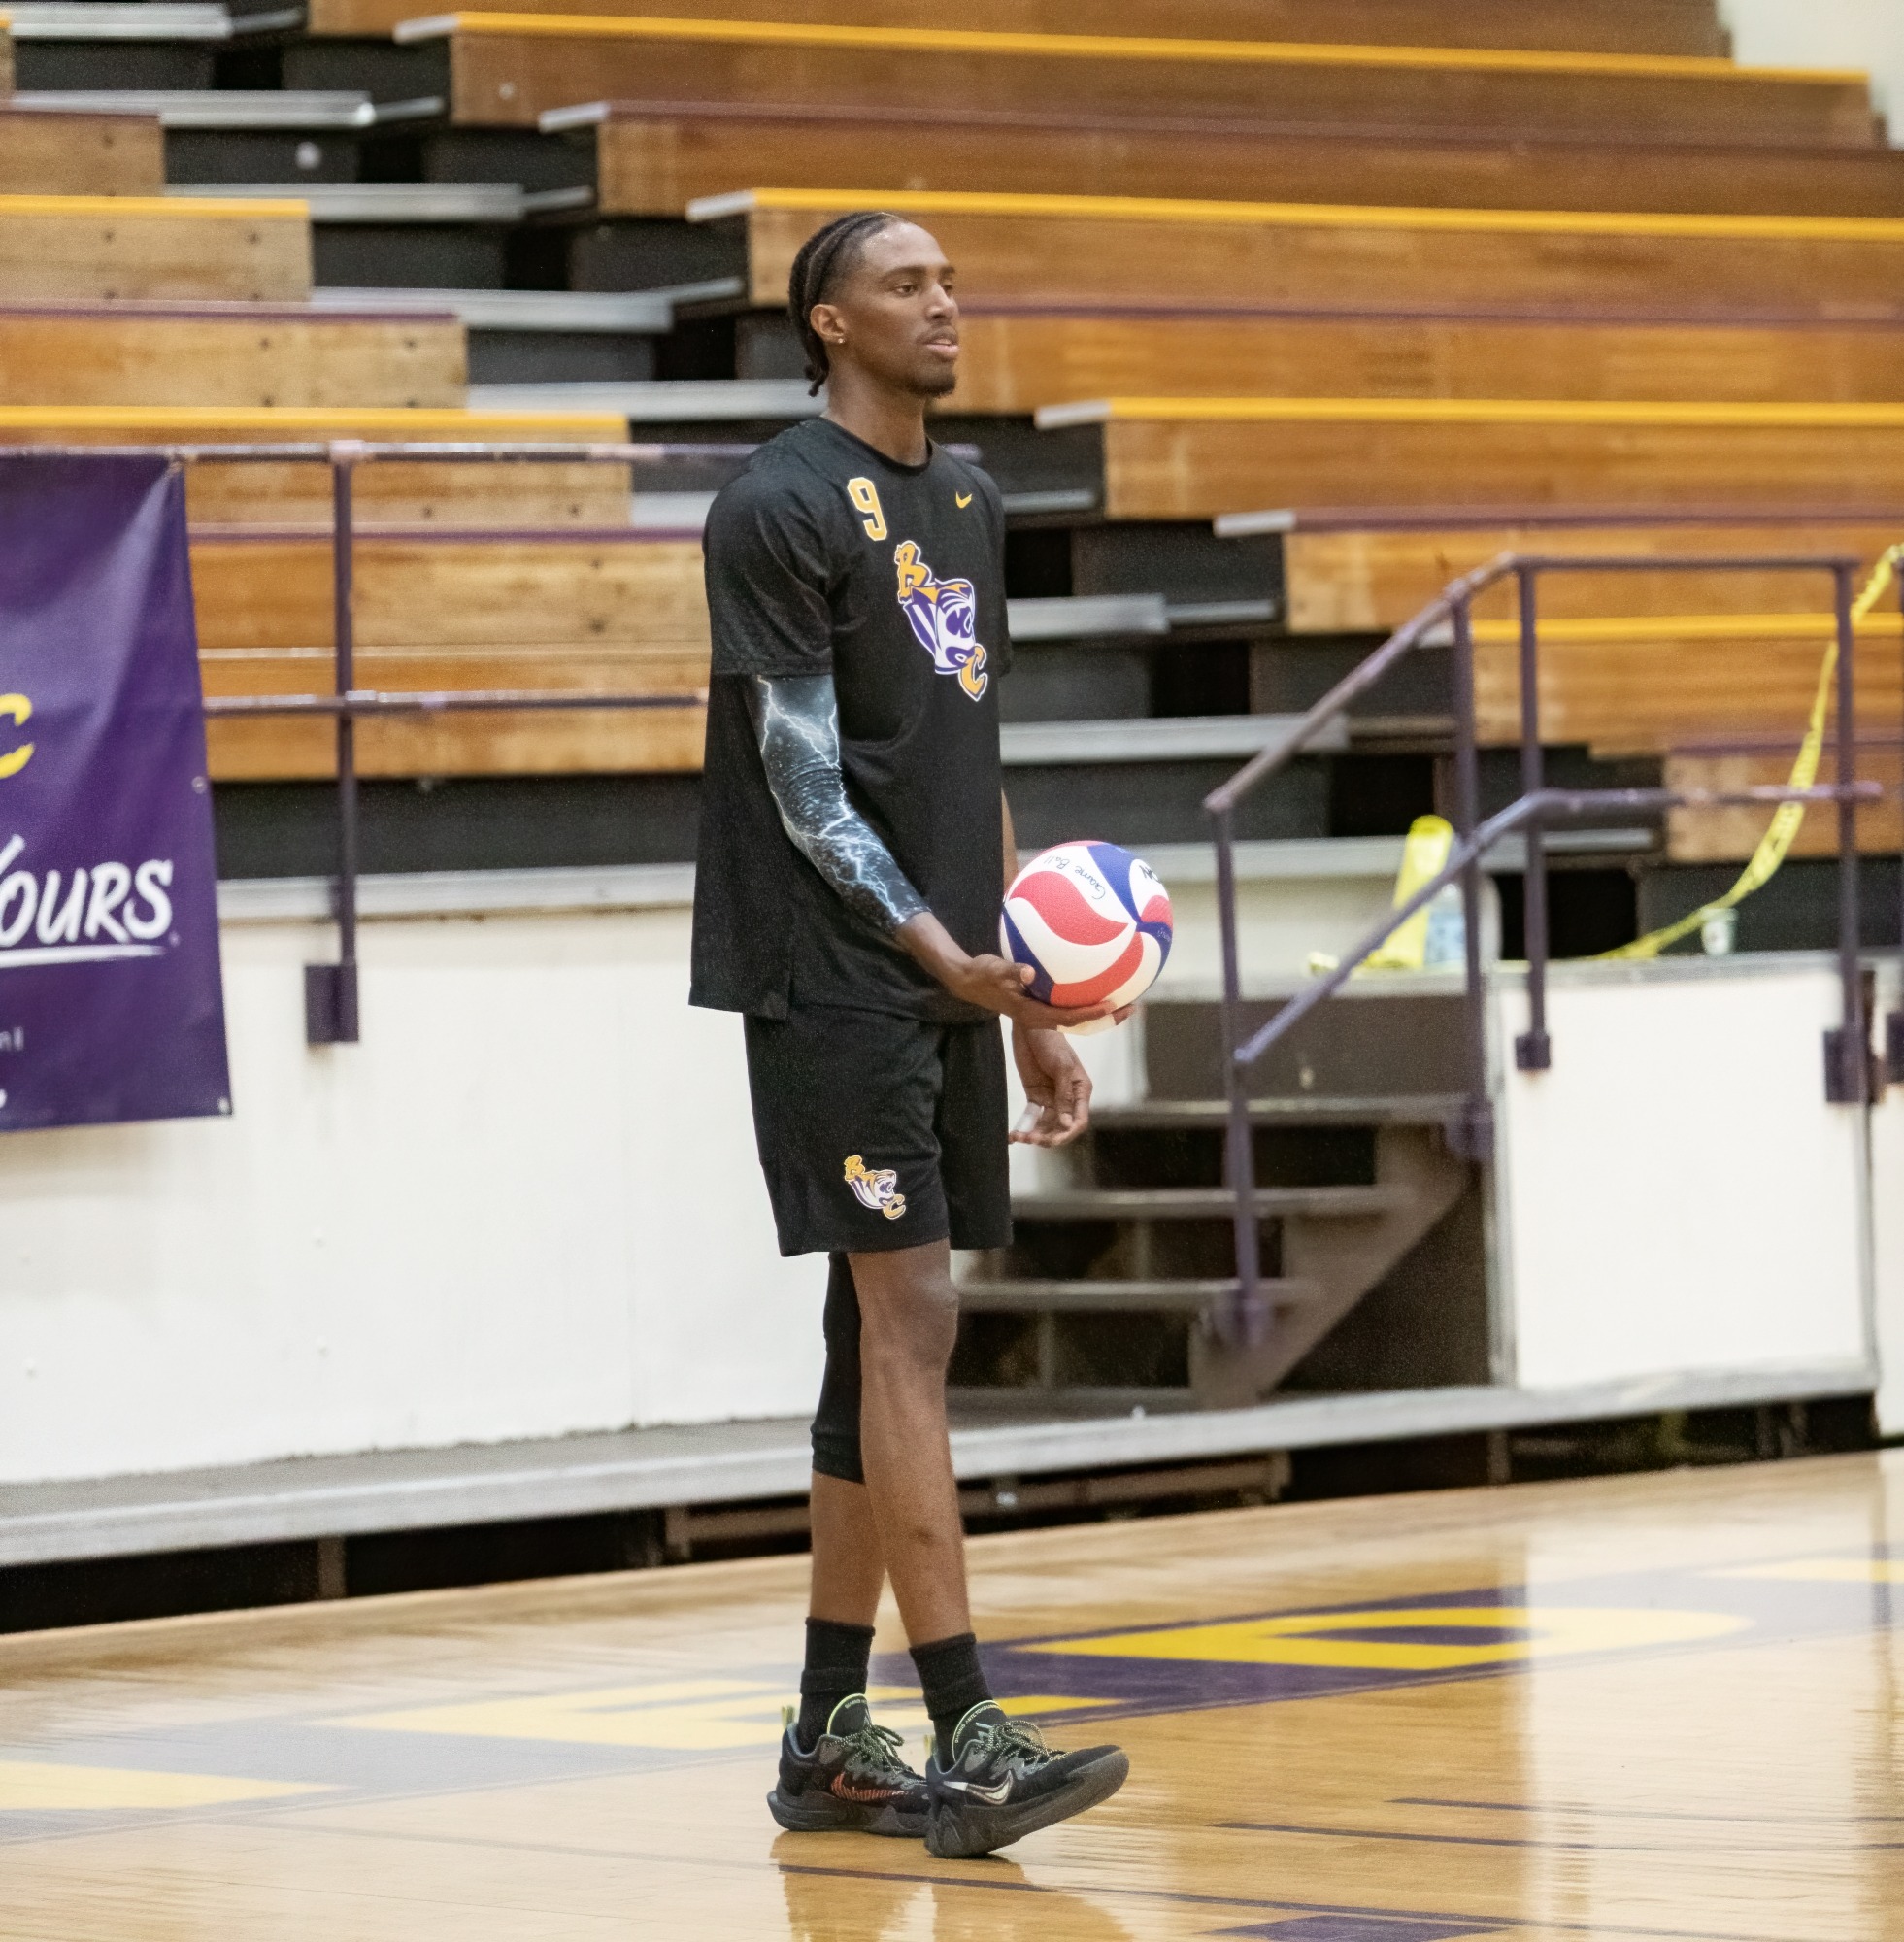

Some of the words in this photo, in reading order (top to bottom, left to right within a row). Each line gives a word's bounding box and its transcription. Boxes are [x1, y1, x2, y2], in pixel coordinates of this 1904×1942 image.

[847, 477, 887, 541] 9
[1043, 855, 1070, 870] Ball
[1074, 865, 1106, 900] Game
[0, 834, 173, 948] OURS
